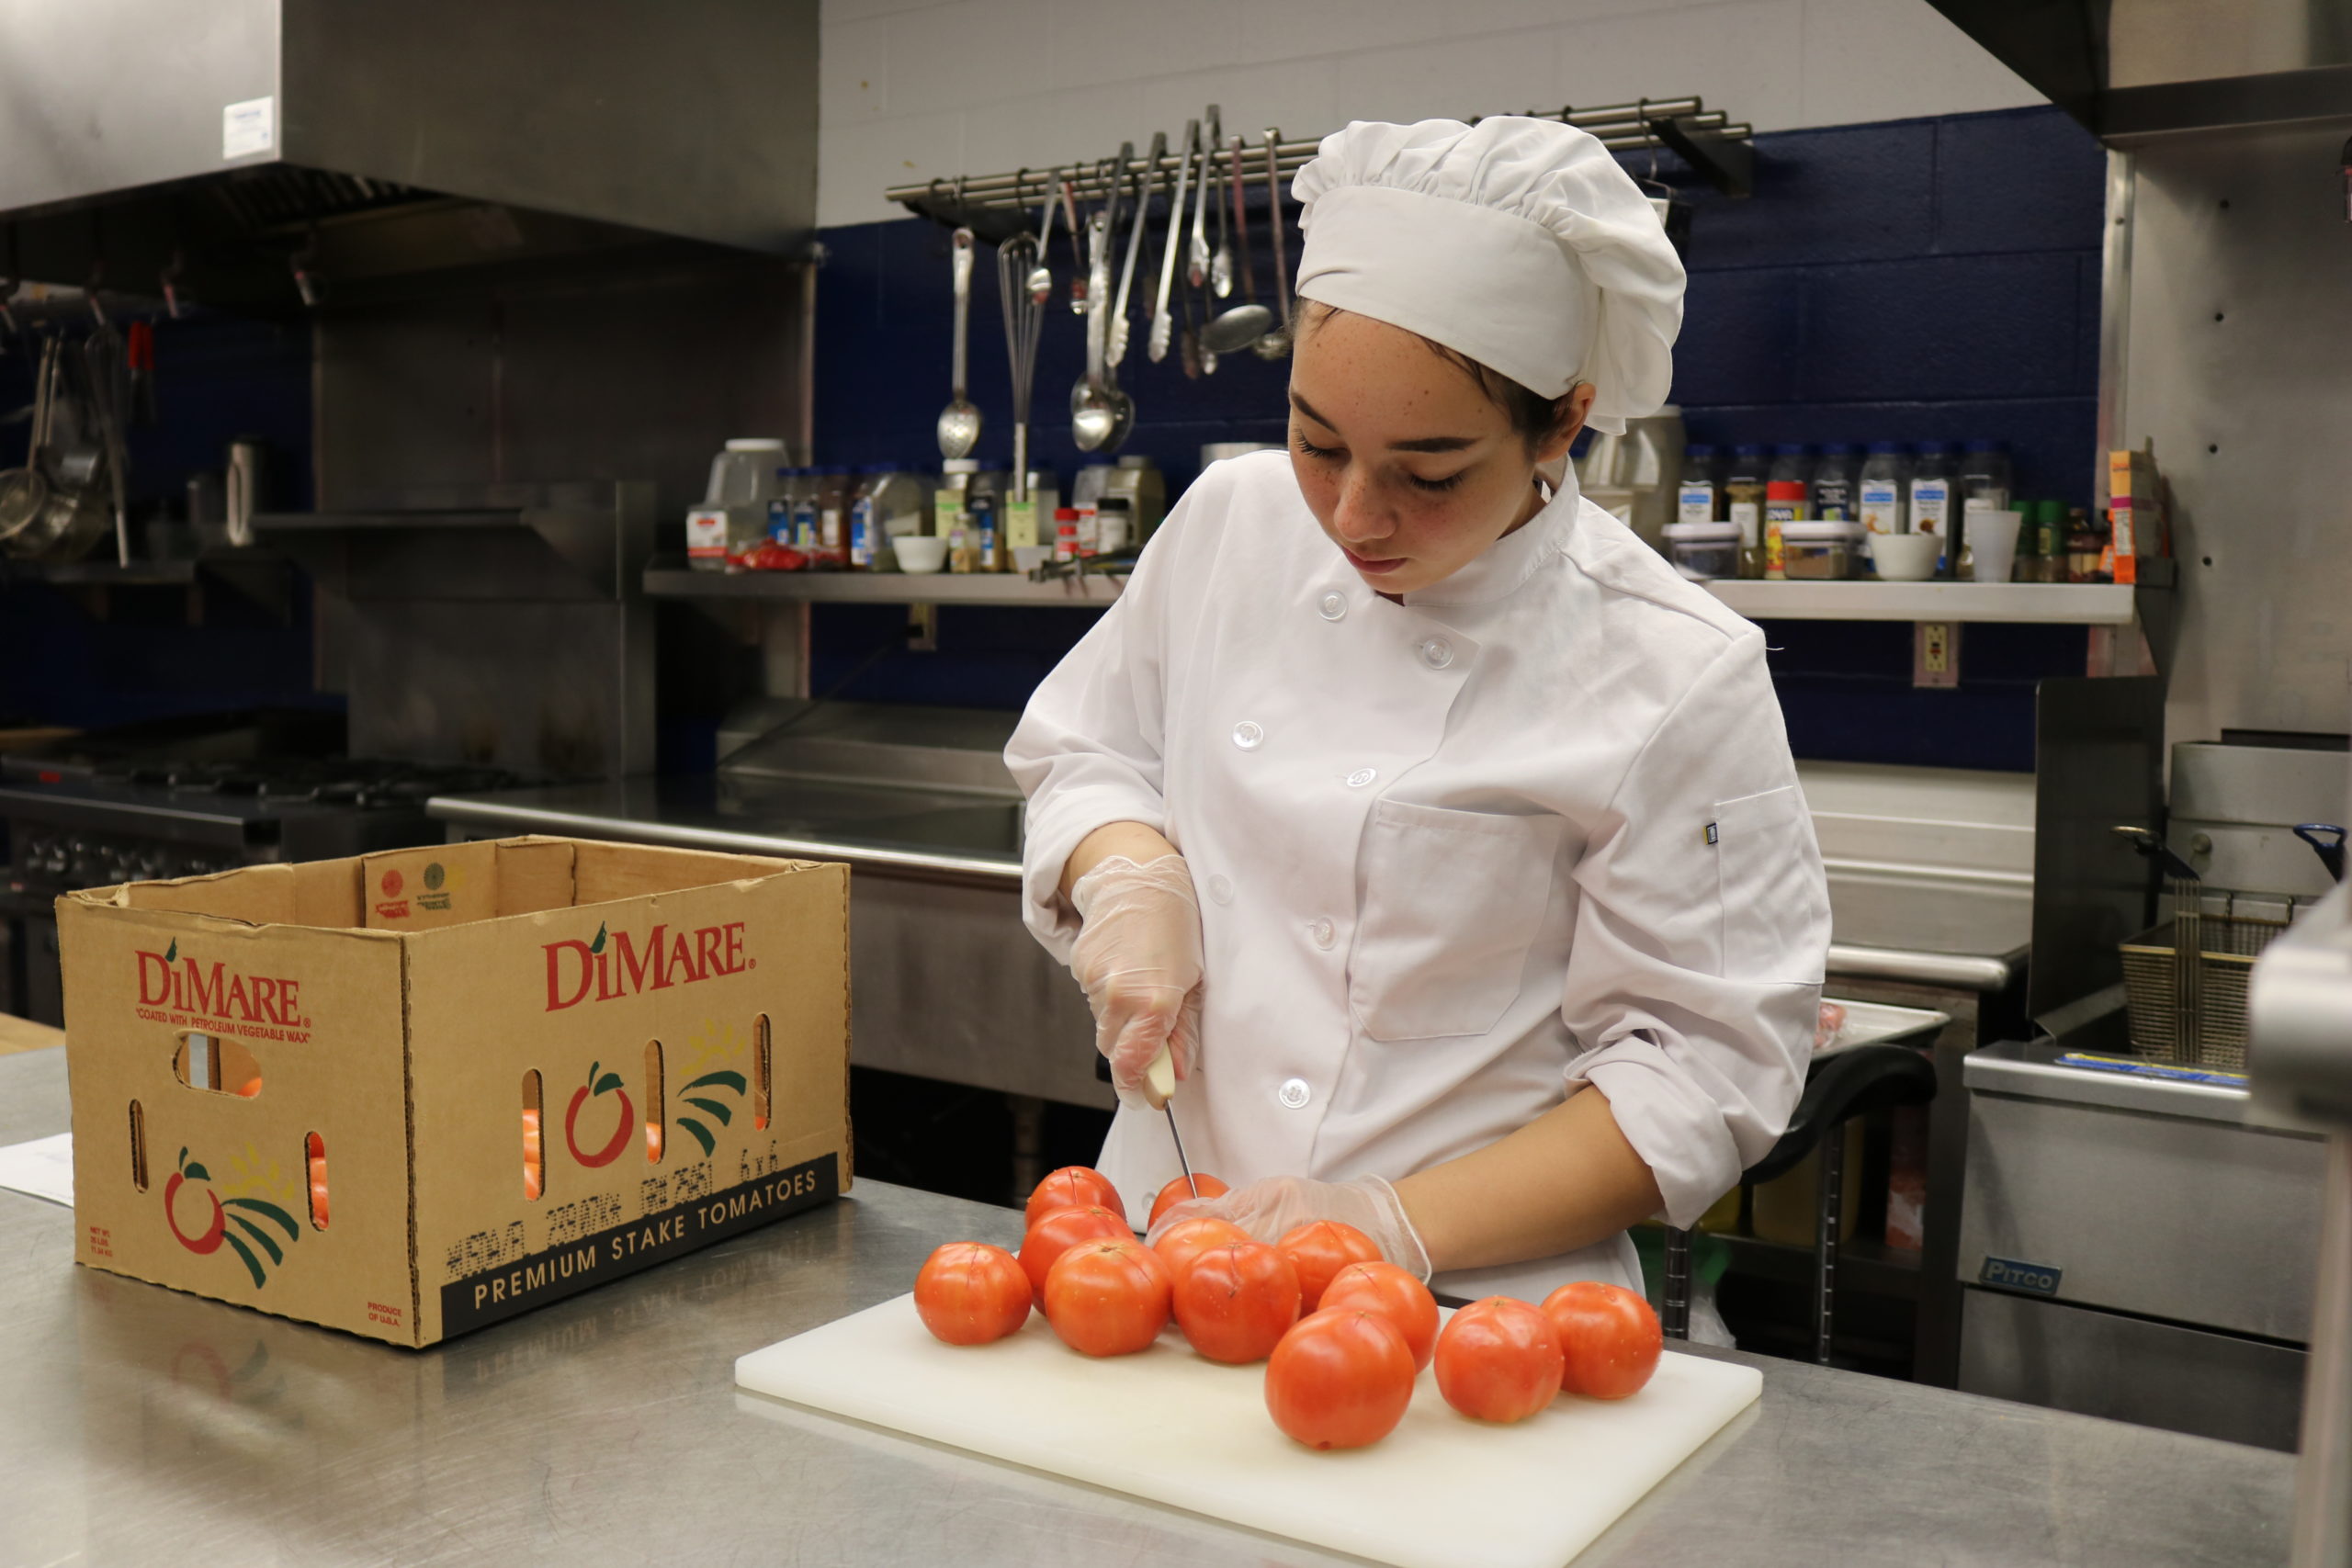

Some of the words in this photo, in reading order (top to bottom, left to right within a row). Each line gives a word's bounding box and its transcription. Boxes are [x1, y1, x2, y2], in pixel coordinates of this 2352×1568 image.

[169, 1013, 187, 1026] WITH
[191, 1016, 235, 1034] PETROLEUM
[237, 1024, 285, 1042] VEGETABLE
[474, 1245, 597, 1310] PREMIUM
[611, 1214, 684, 1260] STAKE
[698, 1169, 816, 1230] TOMATOES
[368, 1302, 401, 1317] PRODUCE
